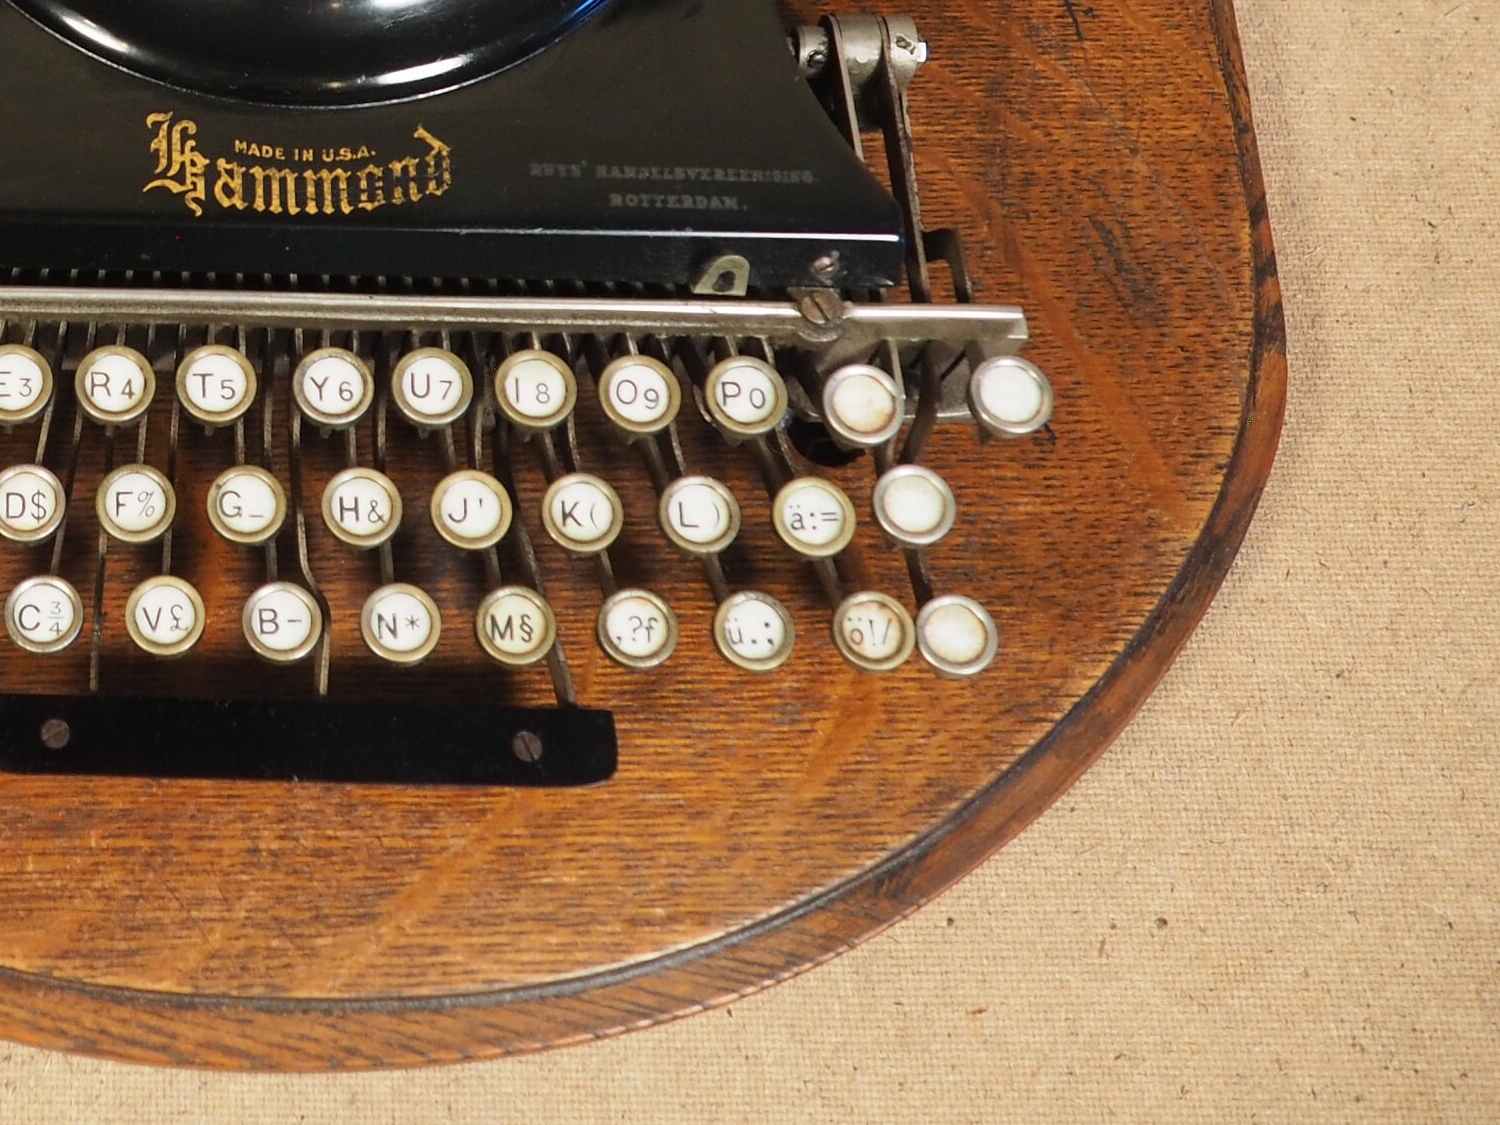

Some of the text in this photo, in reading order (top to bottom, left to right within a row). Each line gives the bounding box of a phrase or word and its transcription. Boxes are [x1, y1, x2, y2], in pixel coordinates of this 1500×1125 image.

[142, 111, 453, 217] Hammond
[234, 139, 377, 162] MADE IN U.S.A.
